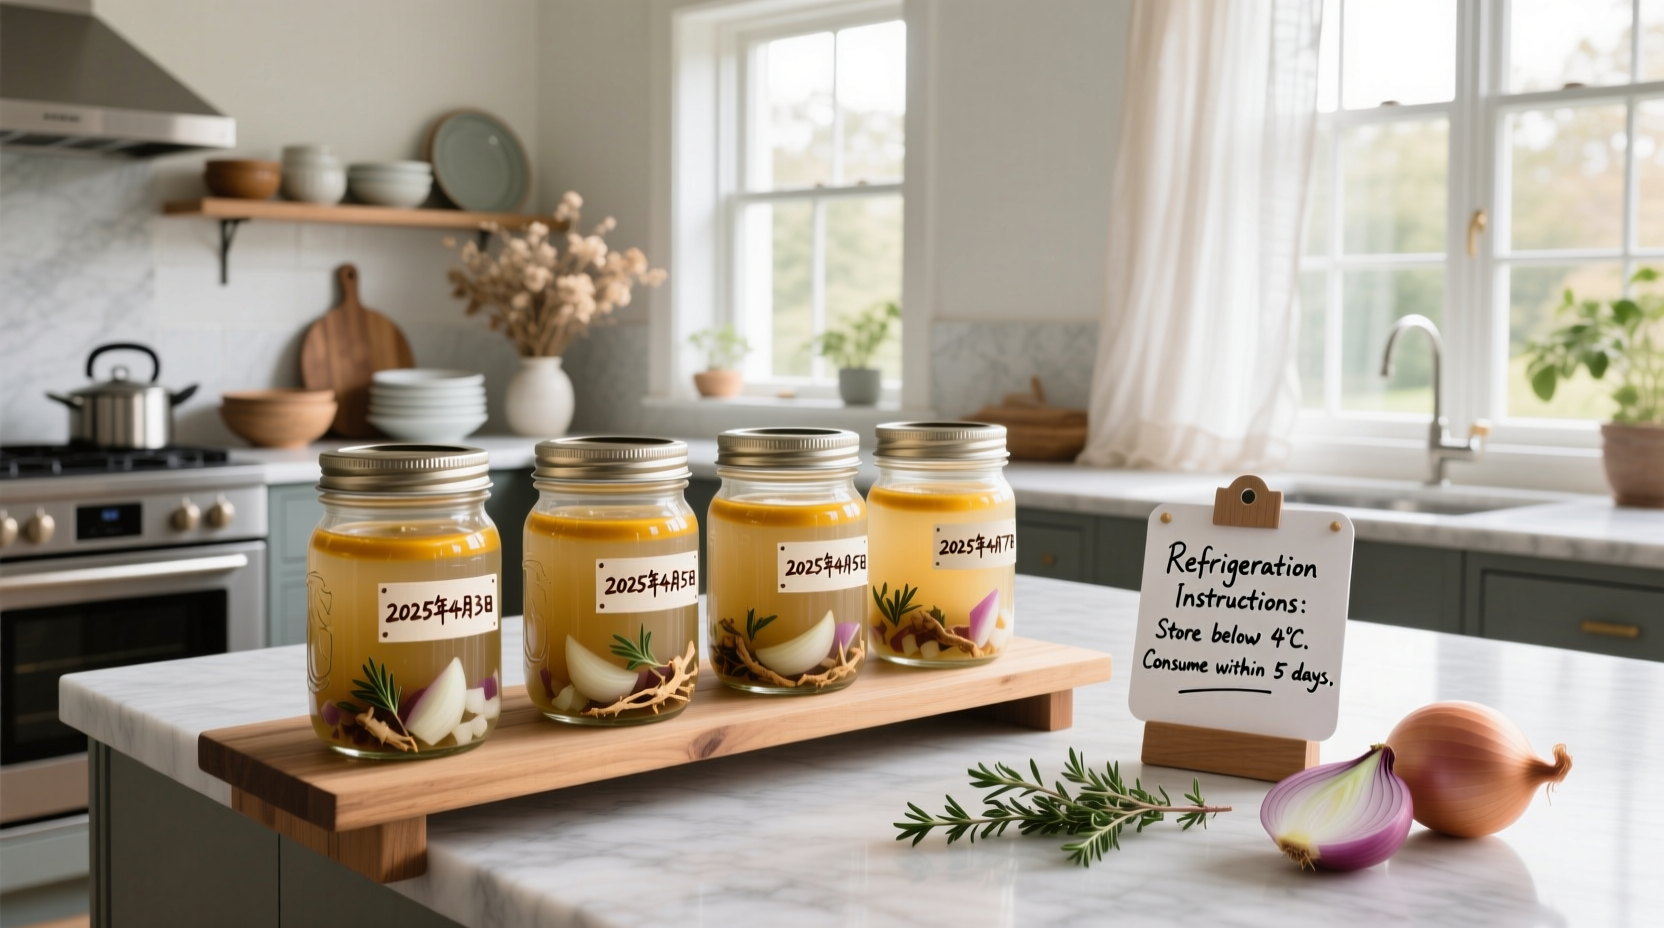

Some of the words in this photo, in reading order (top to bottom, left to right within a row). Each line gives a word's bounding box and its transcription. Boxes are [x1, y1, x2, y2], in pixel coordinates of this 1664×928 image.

[785, 552, 866, 578] 2025年4月5日
[1166, 541, 1317, 588] Refrigeration
[604, 569, 696, 598] 2025年4月5日
[1175, 583, 1306, 614] Instructions:
[385, 594, 493, 626] 2025年4月3日
[1155, 618, 1202, 642] Store
[1211, 622, 1262, 645] below
[1271, 626, 1309, 650] 4°C.
[1142, 648, 1209, 673] Consume
[1215, 657, 1265, 677] within
[1273, 662, 1288, 680] 5
[1291, 662, 1334, 693] days.
